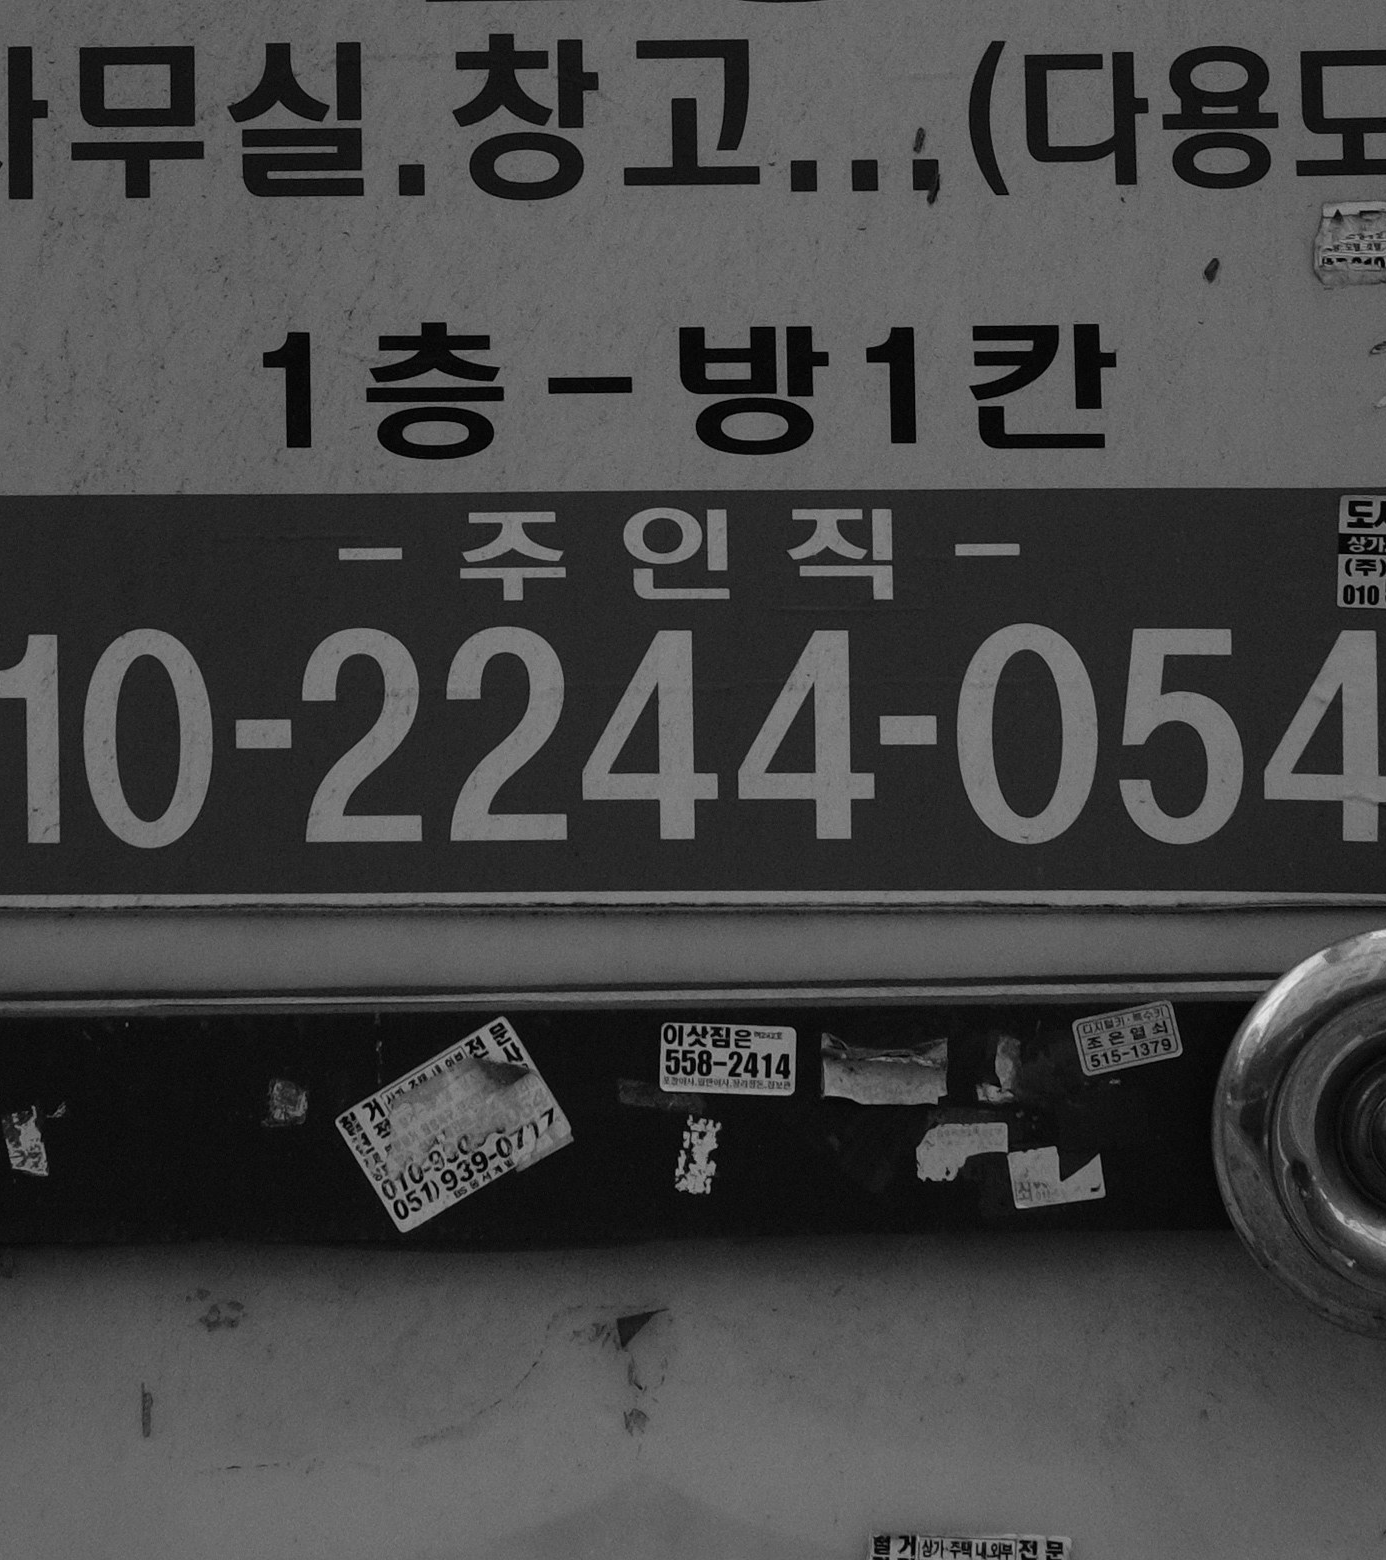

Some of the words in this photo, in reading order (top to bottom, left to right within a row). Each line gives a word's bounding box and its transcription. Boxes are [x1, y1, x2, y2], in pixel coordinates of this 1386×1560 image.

[1343, 584, 1379, 605] 010
[663, 1024, 752, 1049] 이삿짐은
[665, 1049, 791, 1079] 558-2414
[1091, 1038, 1172, 1068] 515-1379
